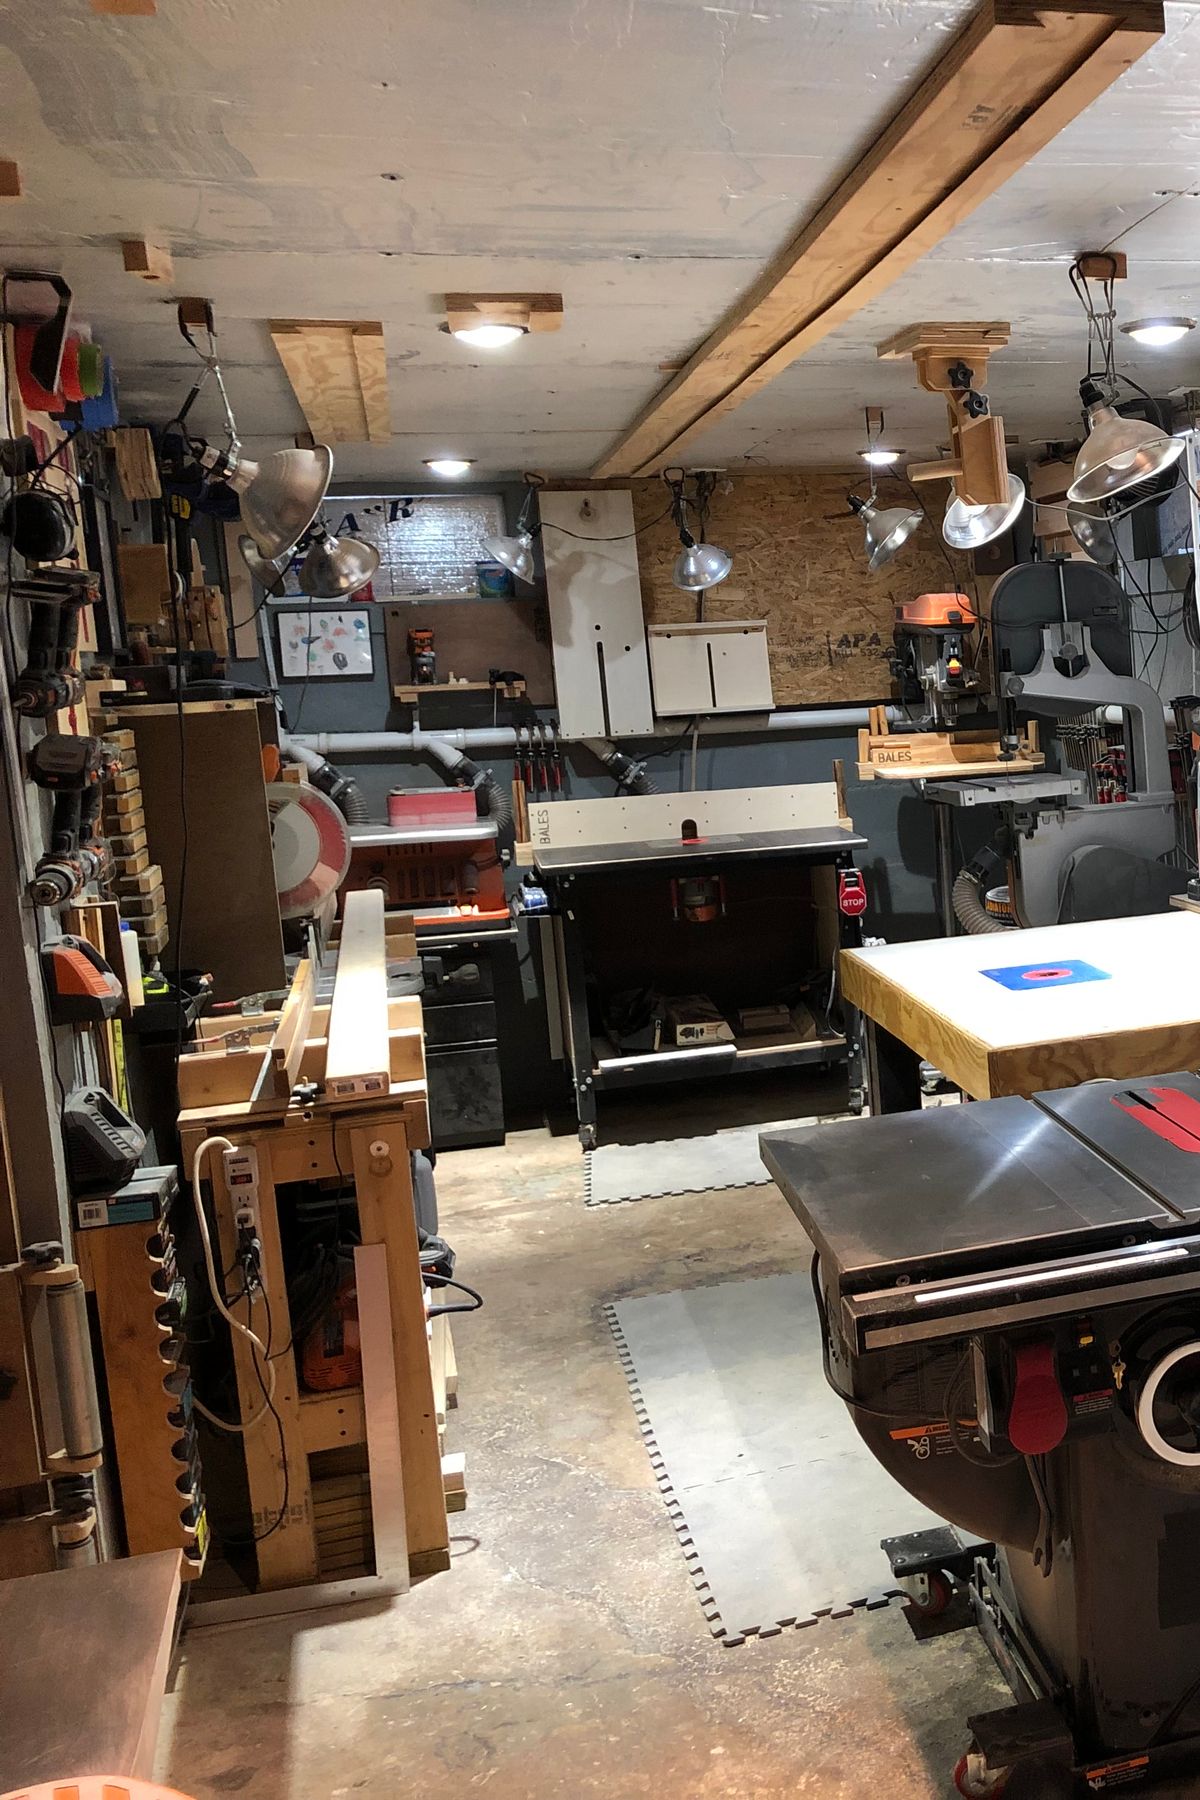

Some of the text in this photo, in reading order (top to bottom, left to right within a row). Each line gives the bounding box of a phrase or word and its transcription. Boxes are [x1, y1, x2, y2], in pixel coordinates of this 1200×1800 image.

[837, 633, 881, 648] APA
[878, 751, 912, 763] BALES
[537, 809, 551, 844] BALES
[843, 899, 864, 907] STOP
